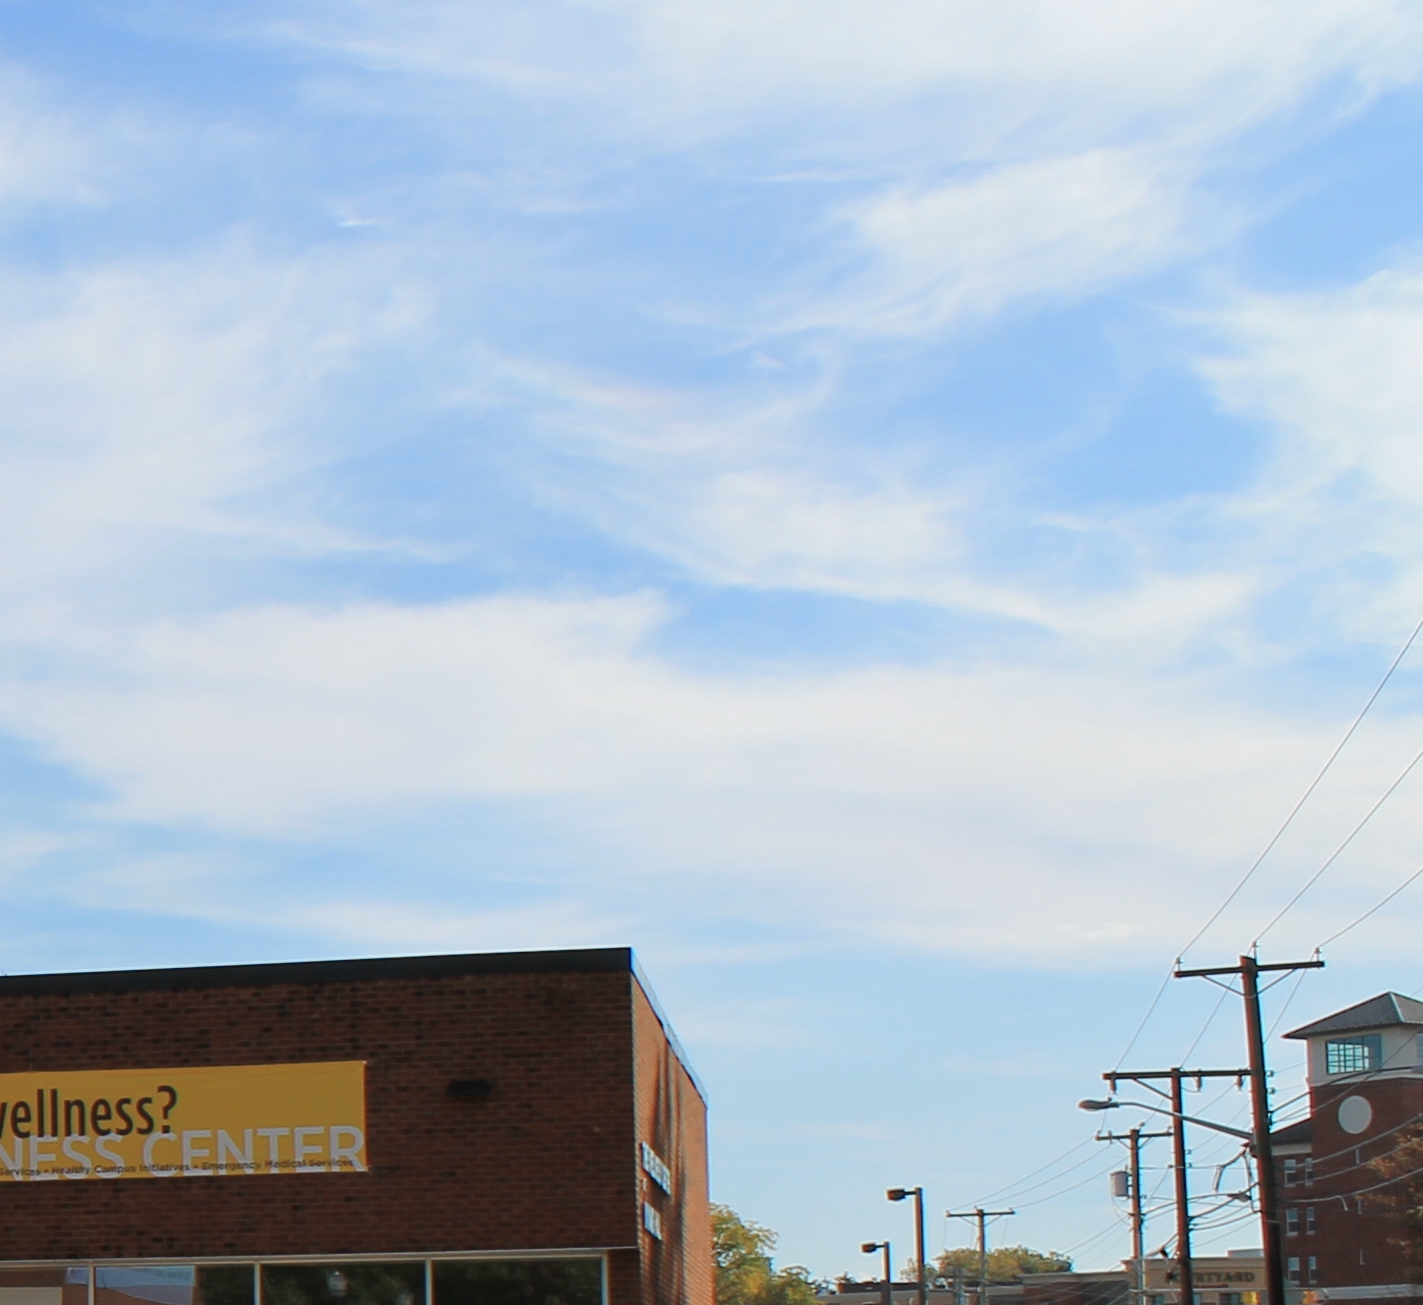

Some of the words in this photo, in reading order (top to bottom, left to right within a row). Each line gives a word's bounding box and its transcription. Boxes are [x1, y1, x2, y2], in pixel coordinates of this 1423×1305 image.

[52, 1165, 91, 1175] Healthy
[93, 1164, 136, 1174] Campus
[202, 1161, 261, 1171] Emergency
[264, 1159, 306, 1168] Medical
[308, 1158, 354, 1167] Services
[142, 1124, 368, 1178] CENTER
